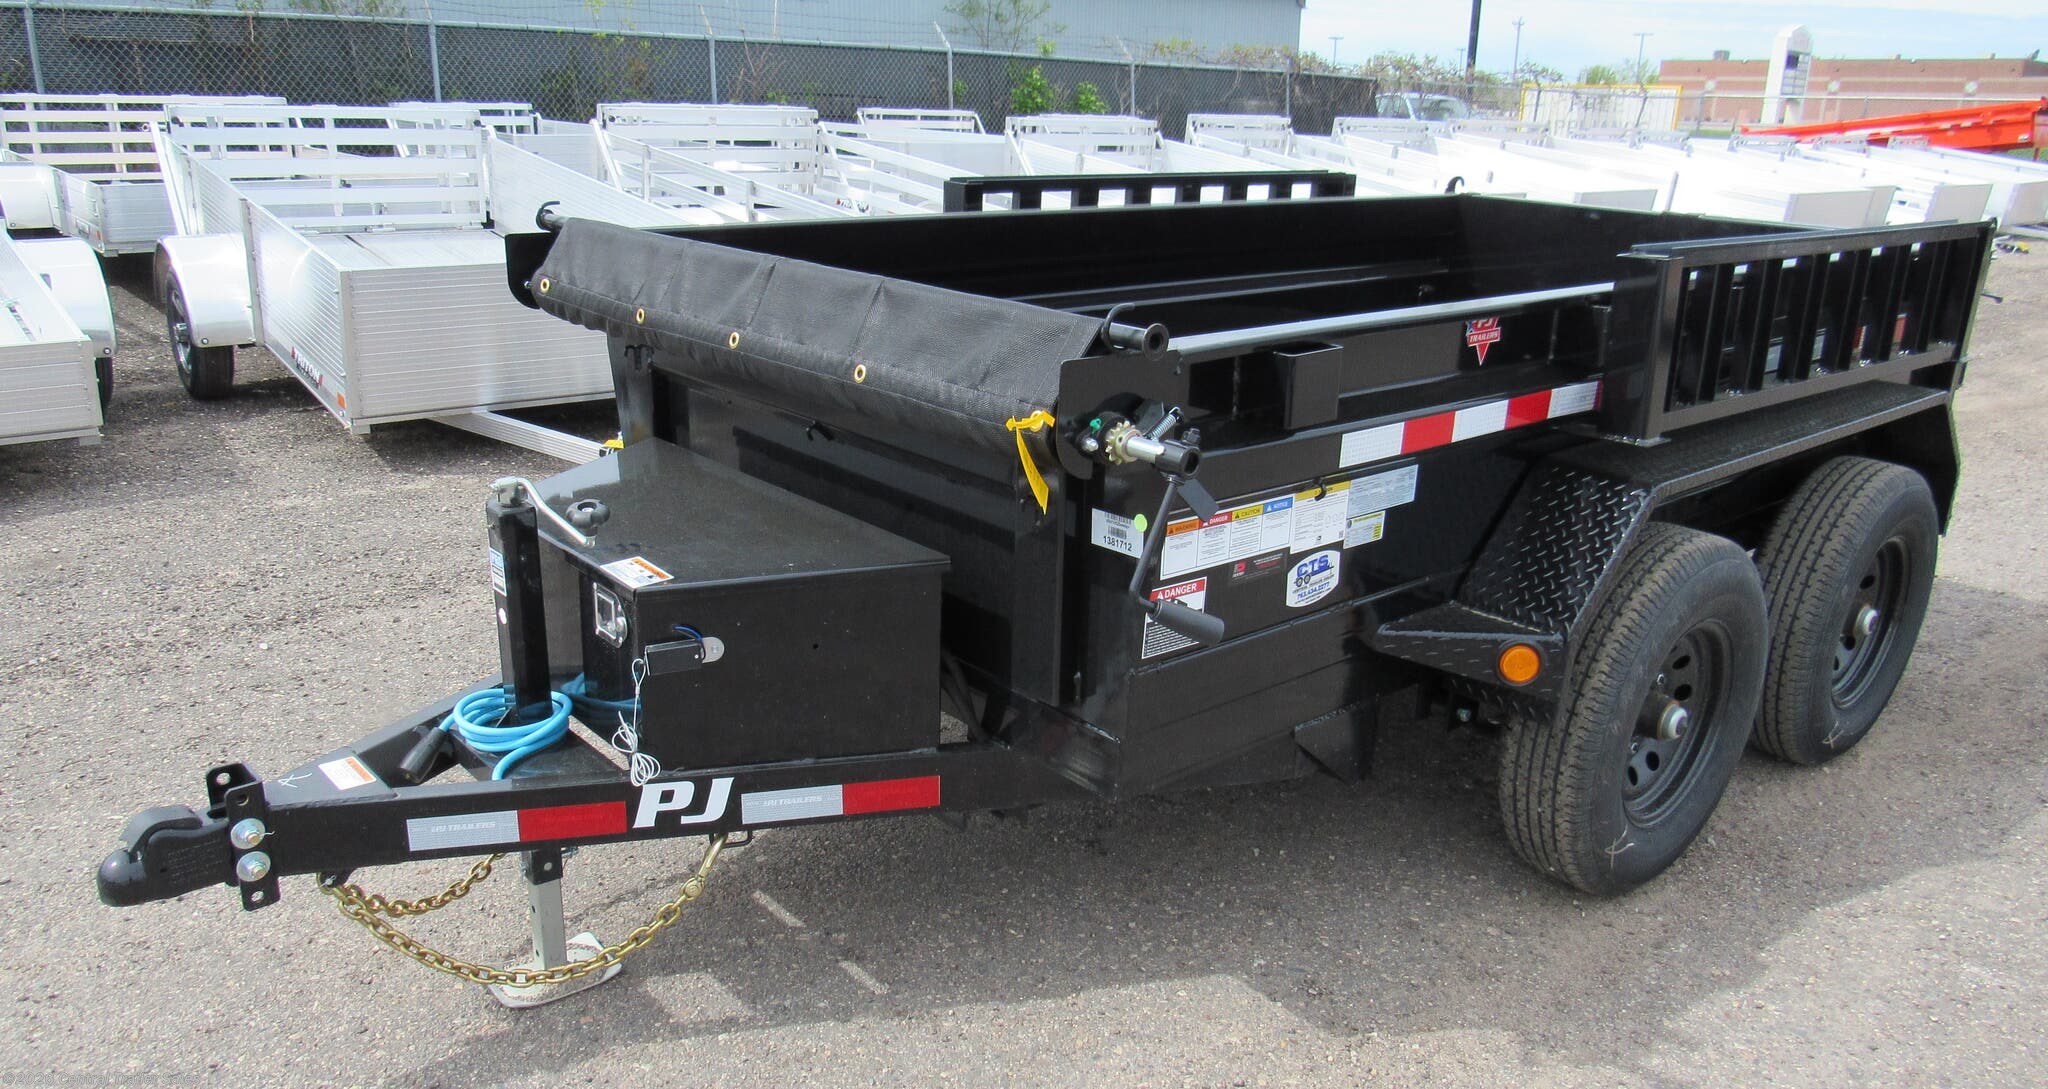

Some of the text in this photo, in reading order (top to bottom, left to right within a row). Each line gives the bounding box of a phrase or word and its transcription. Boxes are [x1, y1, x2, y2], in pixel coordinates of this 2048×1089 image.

[1469, 331, 1498, 343] TRAILERS
[1209, 514, 1229, 526] DANGER
[1240, 507, 1260, 518] CAUTION
[1103, 535, 1133, 552] 1381712
[1296, 554, 1329, 578] CTS
[1164, 582, 1198, 599] DANGER
[632, 776, 735, 829] PJ
